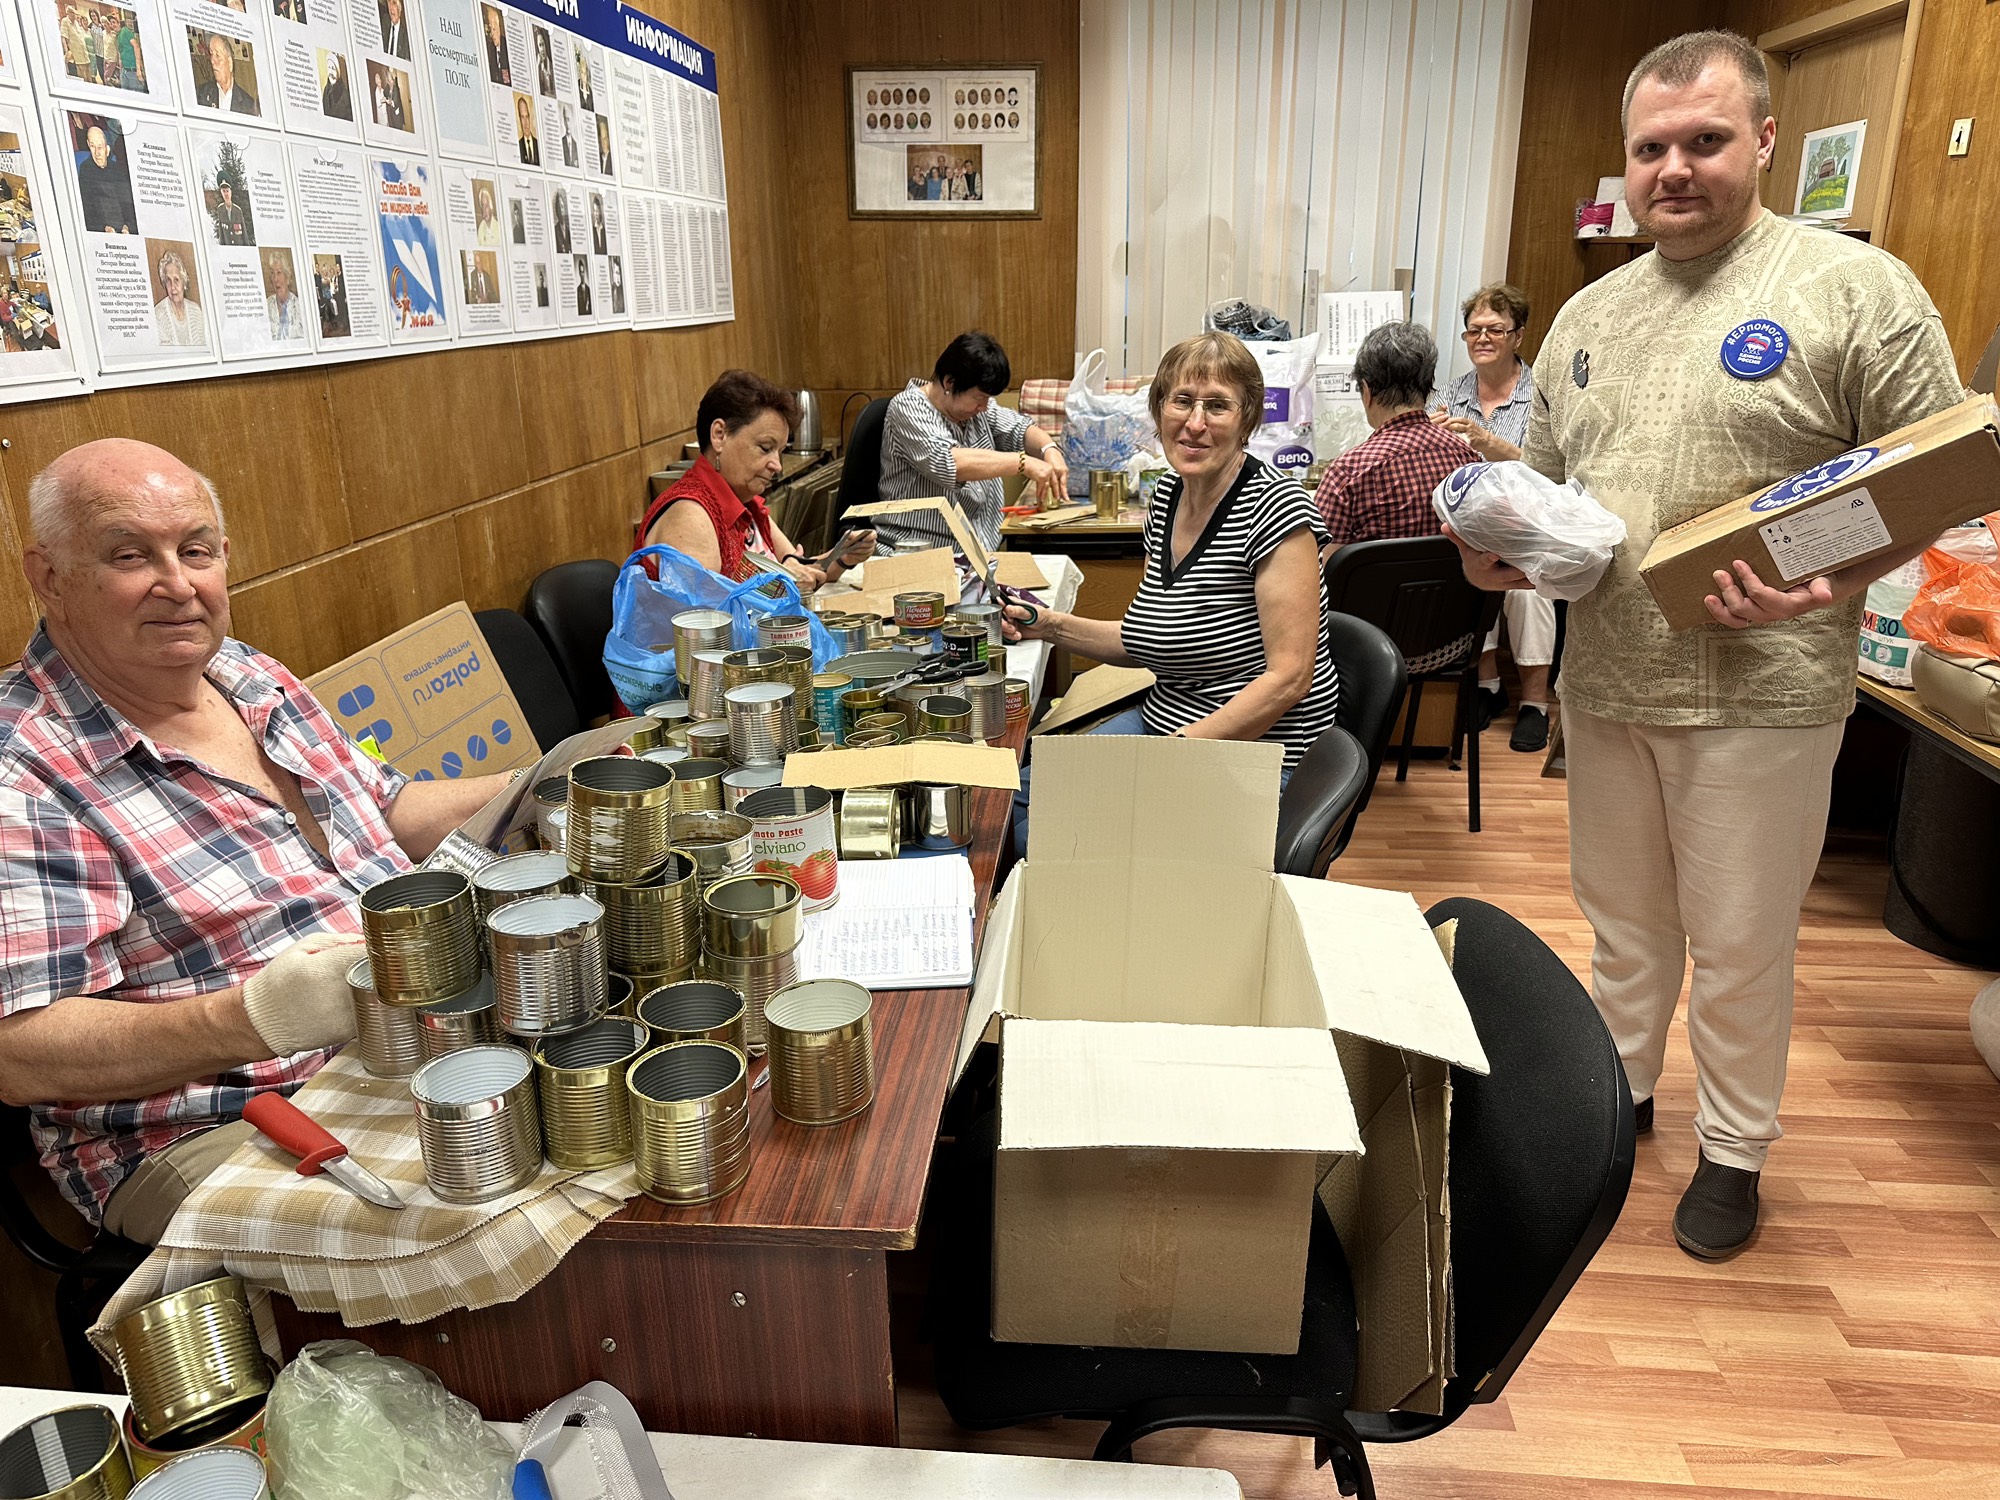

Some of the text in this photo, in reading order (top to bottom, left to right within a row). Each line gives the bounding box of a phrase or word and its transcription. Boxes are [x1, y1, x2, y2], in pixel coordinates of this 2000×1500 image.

[439, 16, 463, 39] НАШ
[428, 38, 479, 68] бессмертный
[625, 14, 704, 76] ИНФОРМАЦИЯ
[444, 68, 471, 90] ПОЛК
[382, 181, 422, 197] Спасибо Вам
[380, 201, 430, 217] за мирное небо!
[410, 314, 434, 328] мая
[1726, 323, 1784, 354] #ЕРпомогает
[1264, 402, 1278, 410] enQ
[1277, 453, 1310, 464] BenQ
[1878, 617, 1899, 636] 30
[403, 640, 471, 682] интернет-аптека
[778, 828, 804, 838] Paste
[754, 841, 806, 854] elviano
